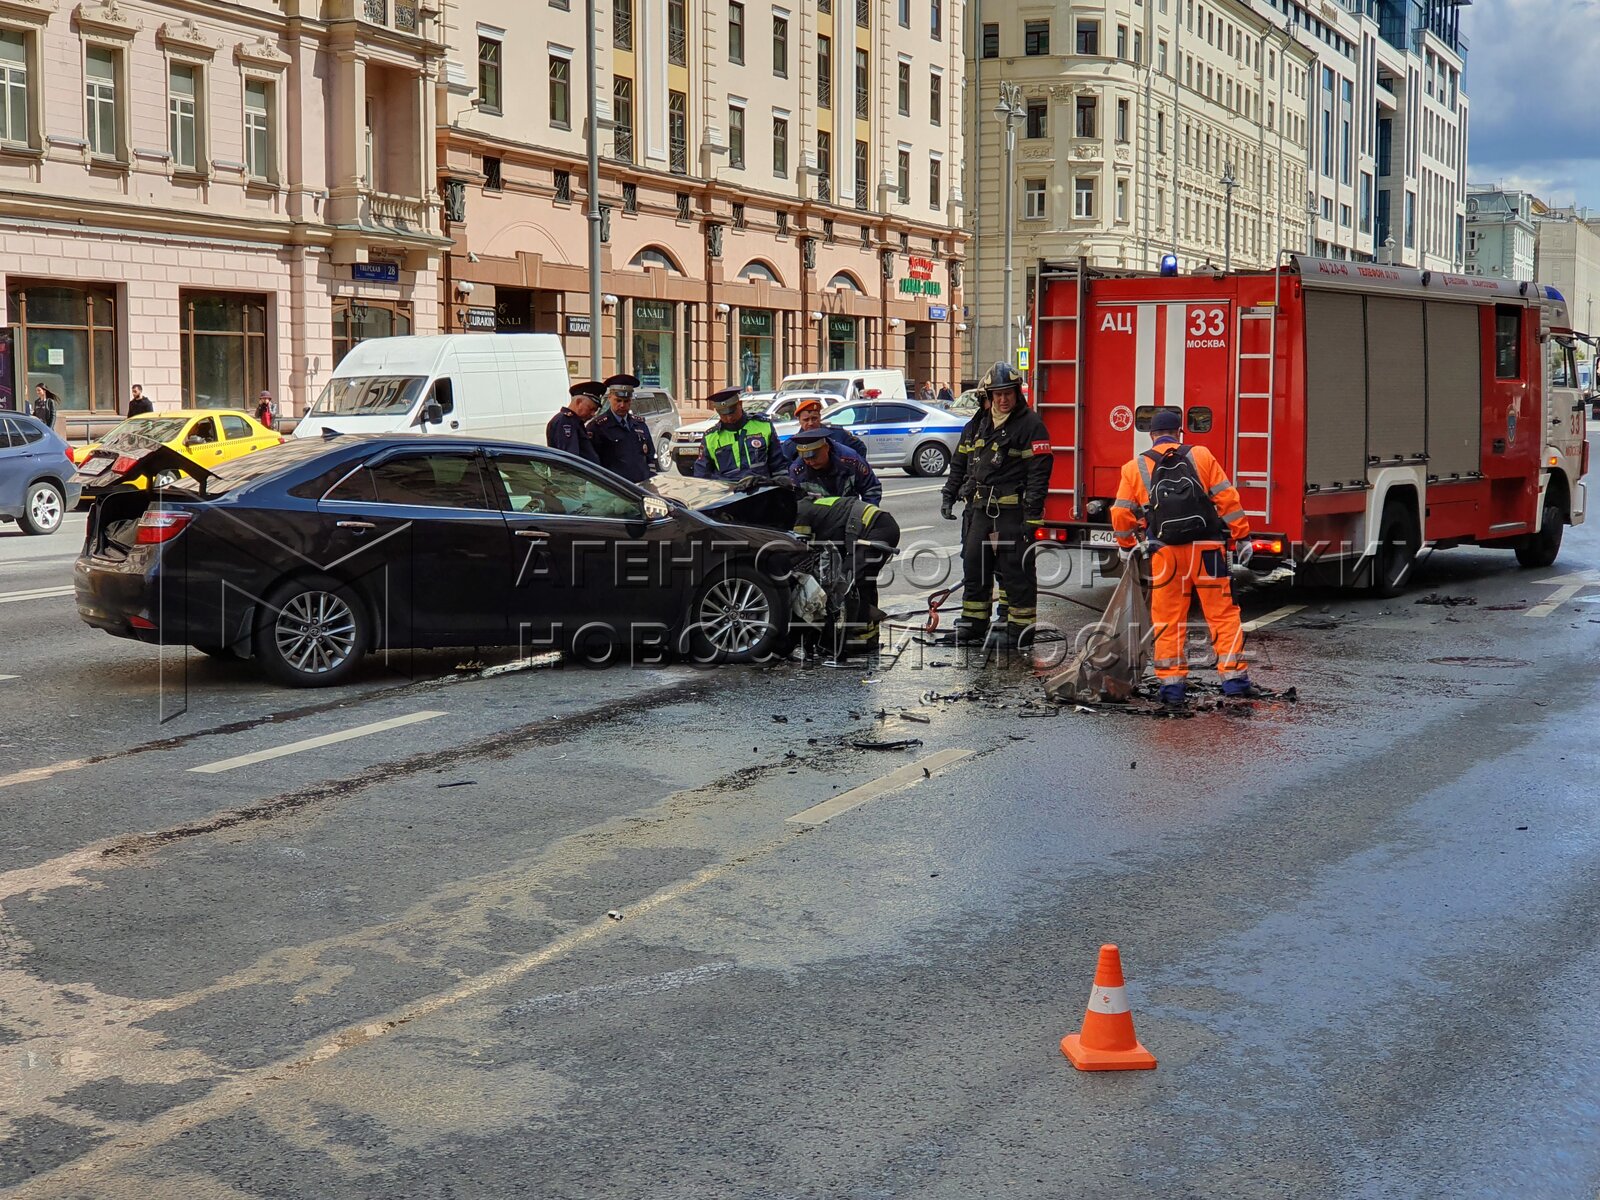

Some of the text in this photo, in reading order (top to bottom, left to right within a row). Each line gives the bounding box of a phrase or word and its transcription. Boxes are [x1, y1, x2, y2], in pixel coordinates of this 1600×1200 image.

[387, 265, 396, 276] 28
[636, 307, 665, 319] CANALI
[497, 317, 521, 325] NALI
[741, 315, 765, 326] CANALI
[1100, 312, 1132, 335] АЦ
[1190, 309, 1225, 336] 33
[569, 322, 590, 333] KURAKI
[830, 322, 850, 332] CANALI
[1186, 339, 1226, 348] МОСКВА
[1570, 414, 1580, 435] 33
